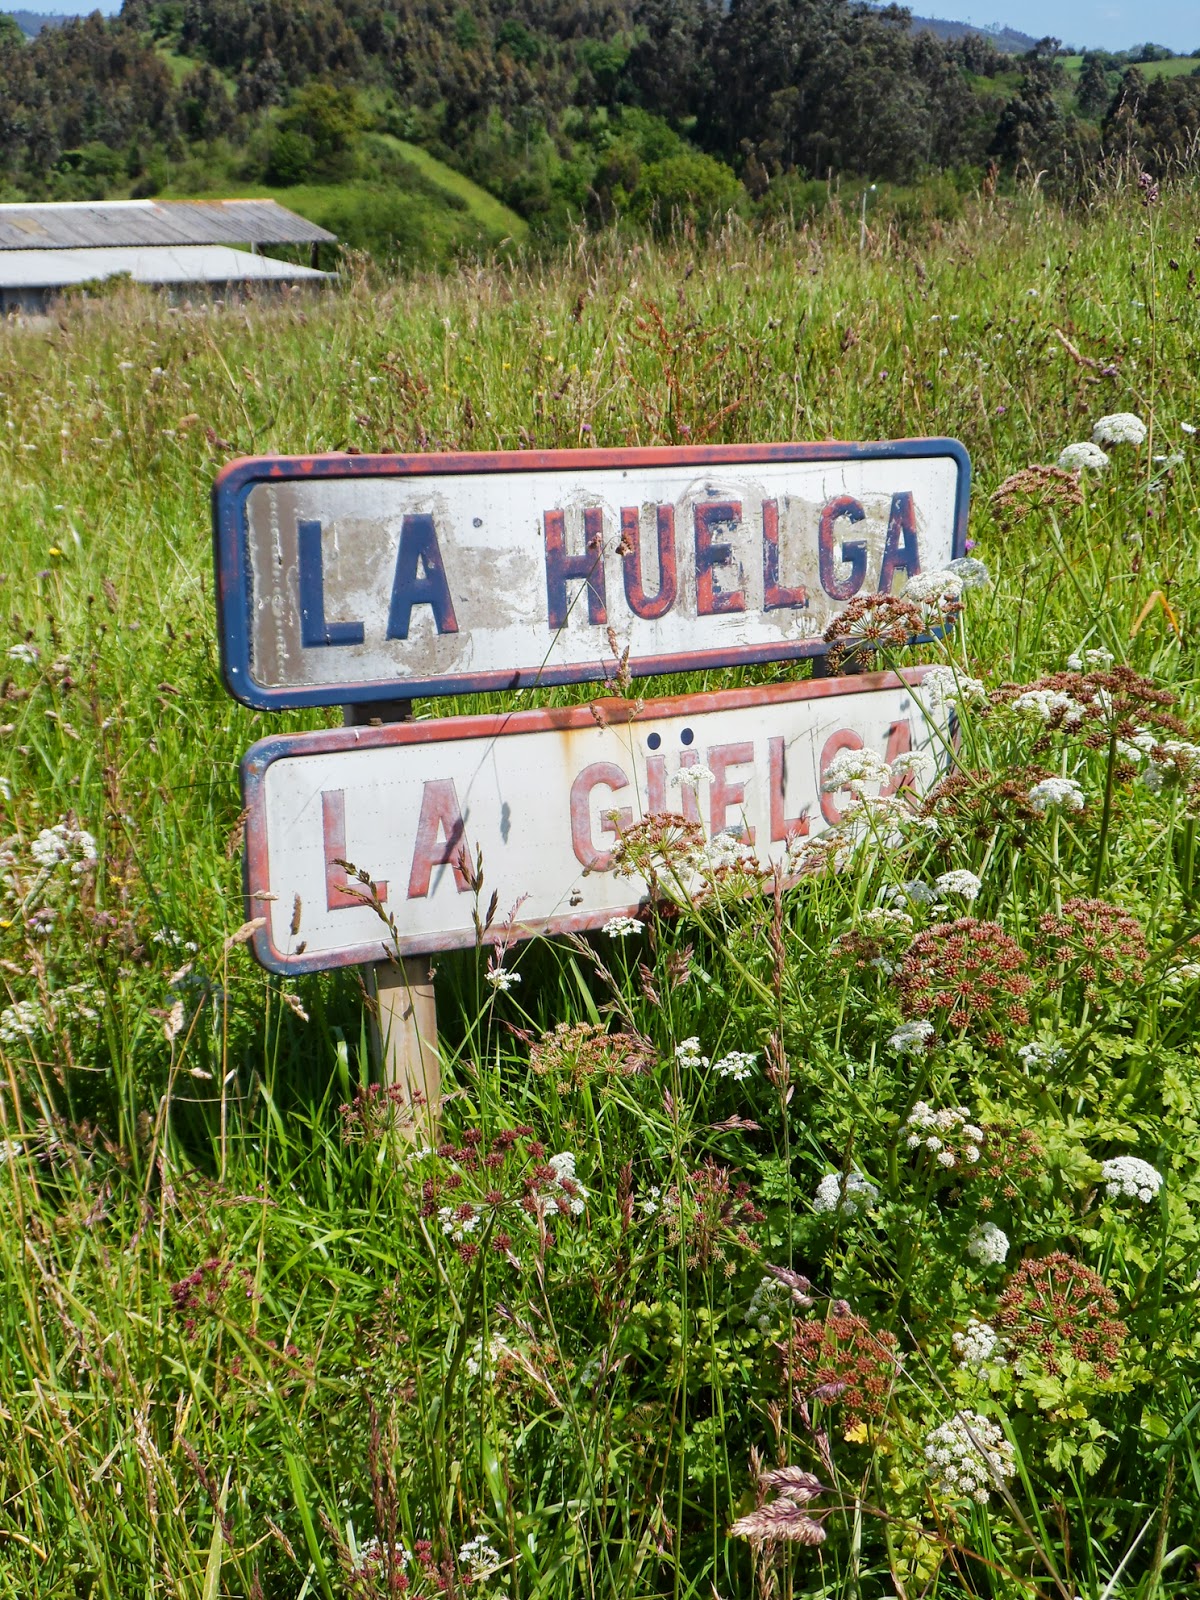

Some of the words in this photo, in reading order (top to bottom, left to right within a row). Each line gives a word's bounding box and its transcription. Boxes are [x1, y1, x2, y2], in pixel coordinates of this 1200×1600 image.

[299, 512, 459, 648] LA
[543, 491, 921, 629] HUELGA
[321, 777, 476, 912] LA
